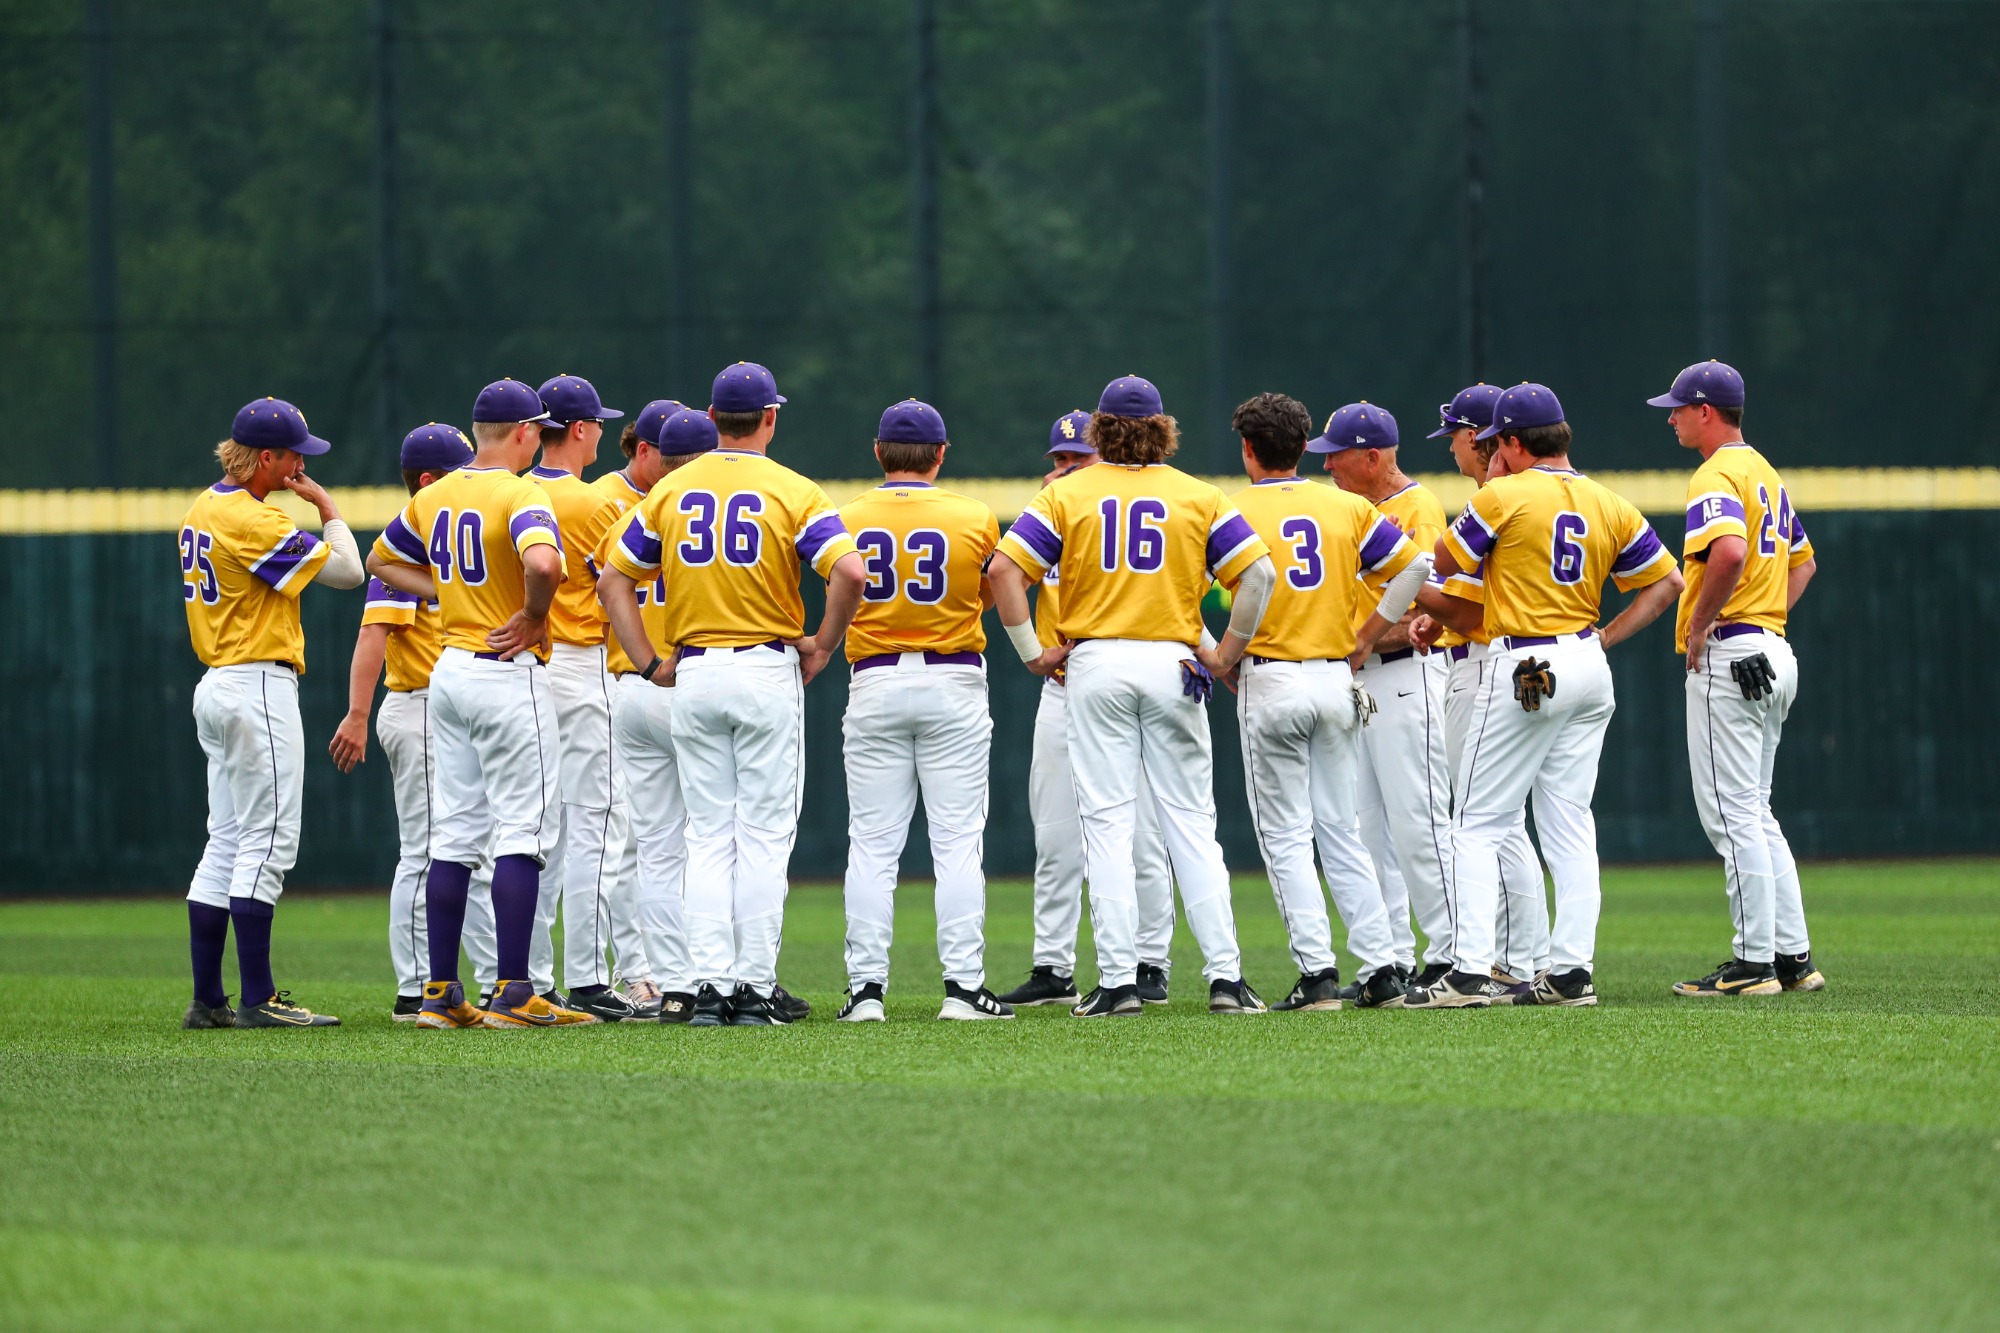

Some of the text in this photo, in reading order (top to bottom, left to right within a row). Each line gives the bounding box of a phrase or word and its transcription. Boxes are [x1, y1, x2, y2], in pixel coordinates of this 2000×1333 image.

[428, 506, 488, 587] 40
[677, 488, 766, 568] 36
[1098, 495, 1169, 575] 16
[1550, 509, 1589, 587] 6
[1702, 498, 1723, 524] AE
[1757, 482, 1790, 558] 24
[179, 525, 221, 607] 25
[854, 527, 949, 606] 33
[1279, 514, 1326, 592] 3
